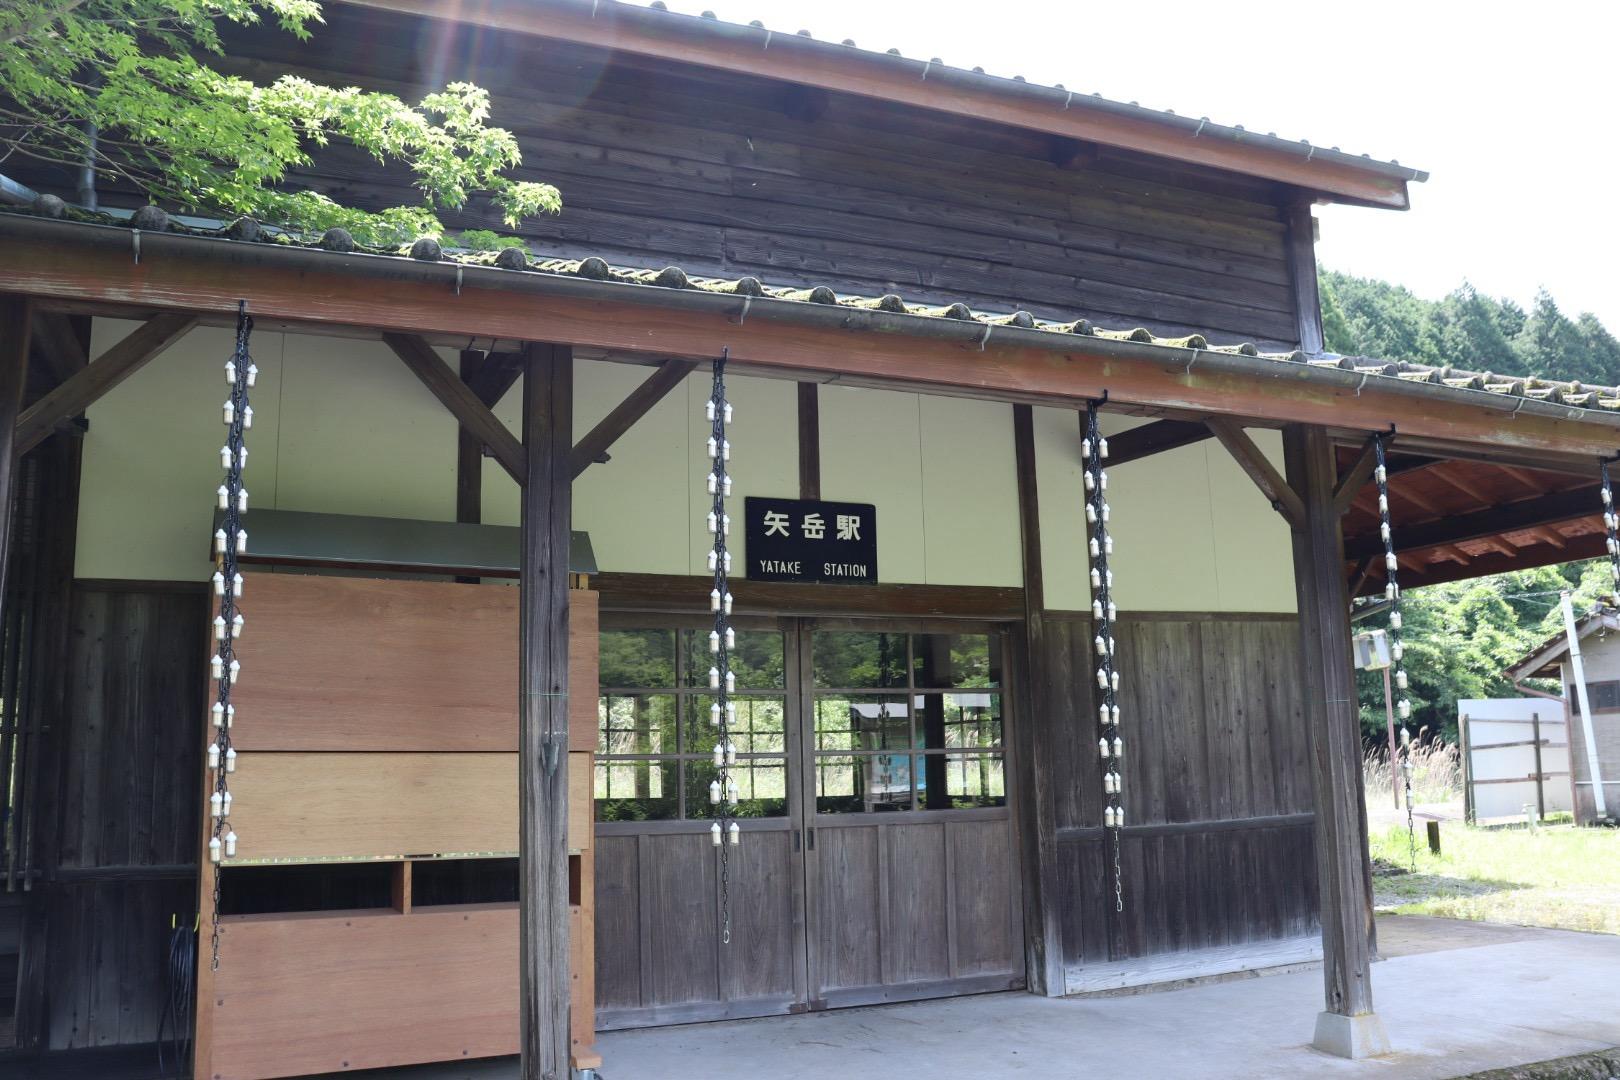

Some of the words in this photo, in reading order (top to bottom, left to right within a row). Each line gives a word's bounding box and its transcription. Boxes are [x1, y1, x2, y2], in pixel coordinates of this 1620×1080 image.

[763, 510, 861, 541] 矢岳駅
[760, 559, 802, 575] YATAKE
[824, 562, 867, 577] STATION
